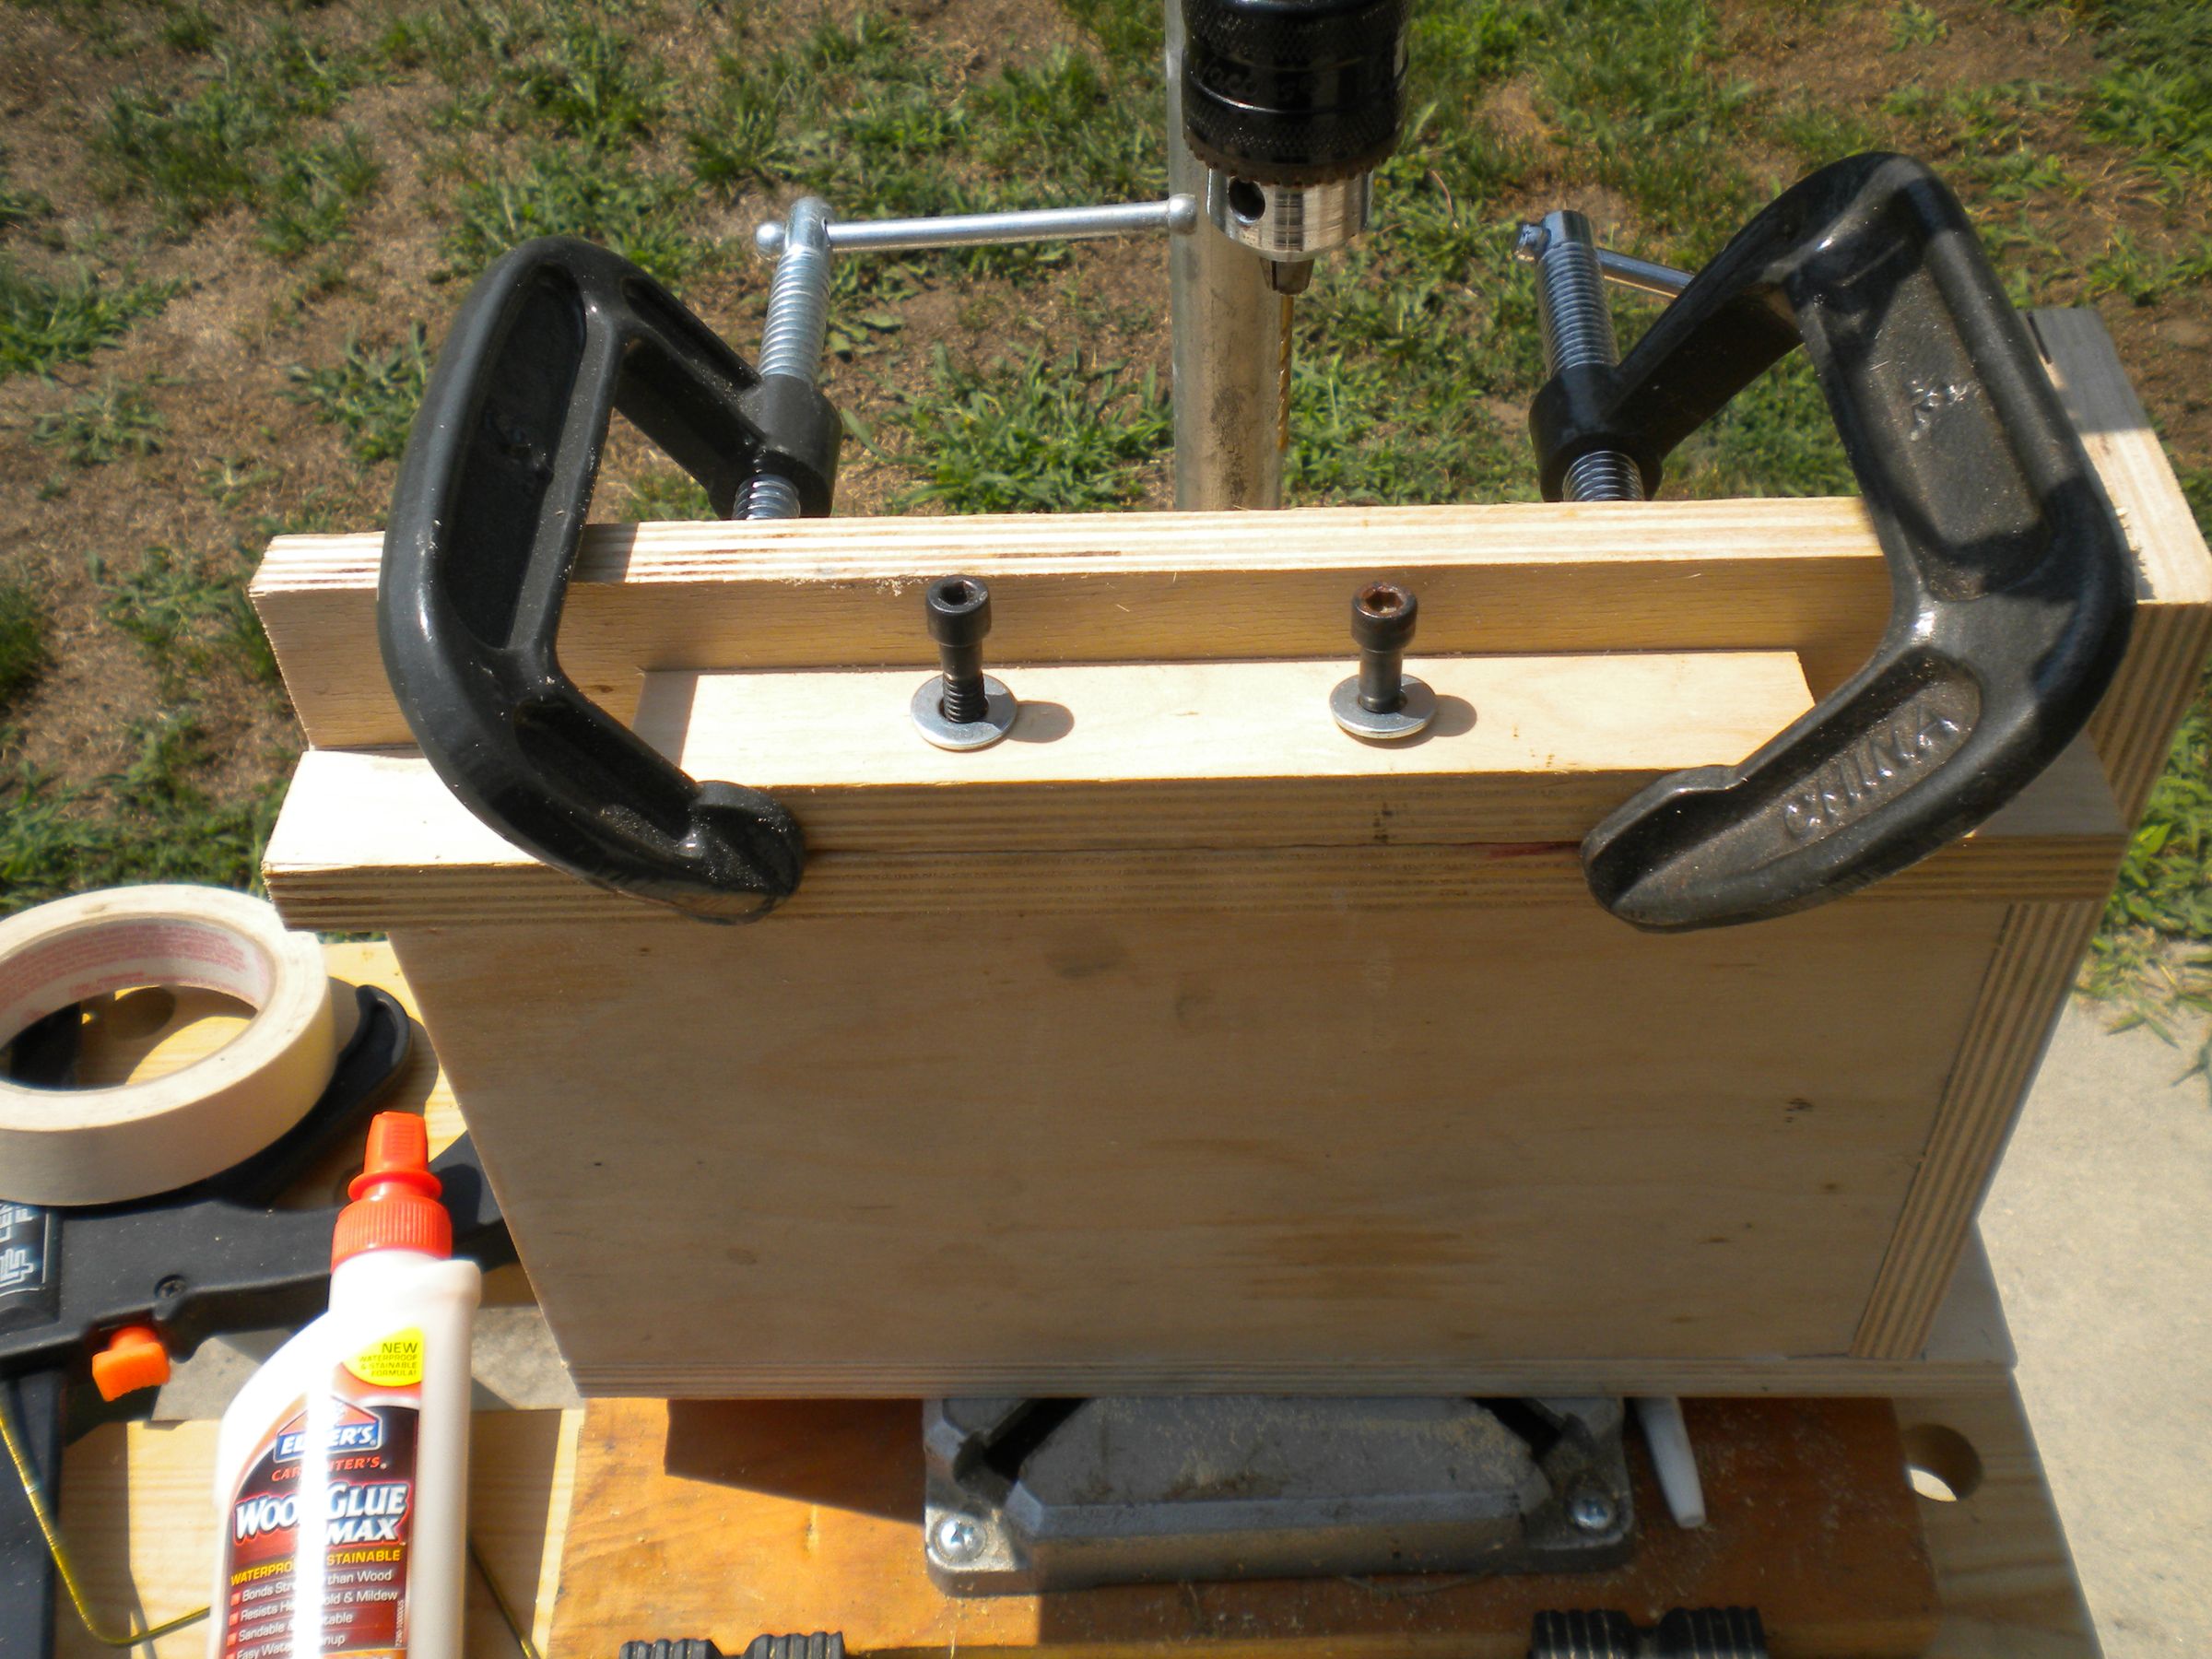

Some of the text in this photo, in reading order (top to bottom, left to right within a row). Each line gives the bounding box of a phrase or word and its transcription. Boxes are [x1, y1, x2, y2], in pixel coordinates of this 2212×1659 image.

[1783, 704, 1959, 835] CHINA
[359, 1354, 418, 1362] WATERPROOF
[382, 1342, 418, 1354] NEW
[370, 1361, 417, 1370] STAINABLE
[280, 1426, 373, 1455] ELER'S
[271, 1456, 381, 1481] CARTER'S
[235, 1494, 300, 1541] WOO
[325, 1515, 399, 1546] MAX
[230, 1550, 400, 1586] WATERPRO STAINABLE
[242, 1584, 274, 1602] Bonds
[327, 1572, 354, 1585] than
[357, 1569, 393, 1583] Wood
[240, 1605, 277, 1622] Resists
[344, 1591, 353, 1604] &
[356, 1589, 398, 1602] Mildew
[238, 1622, 285, 1642] Sandable
